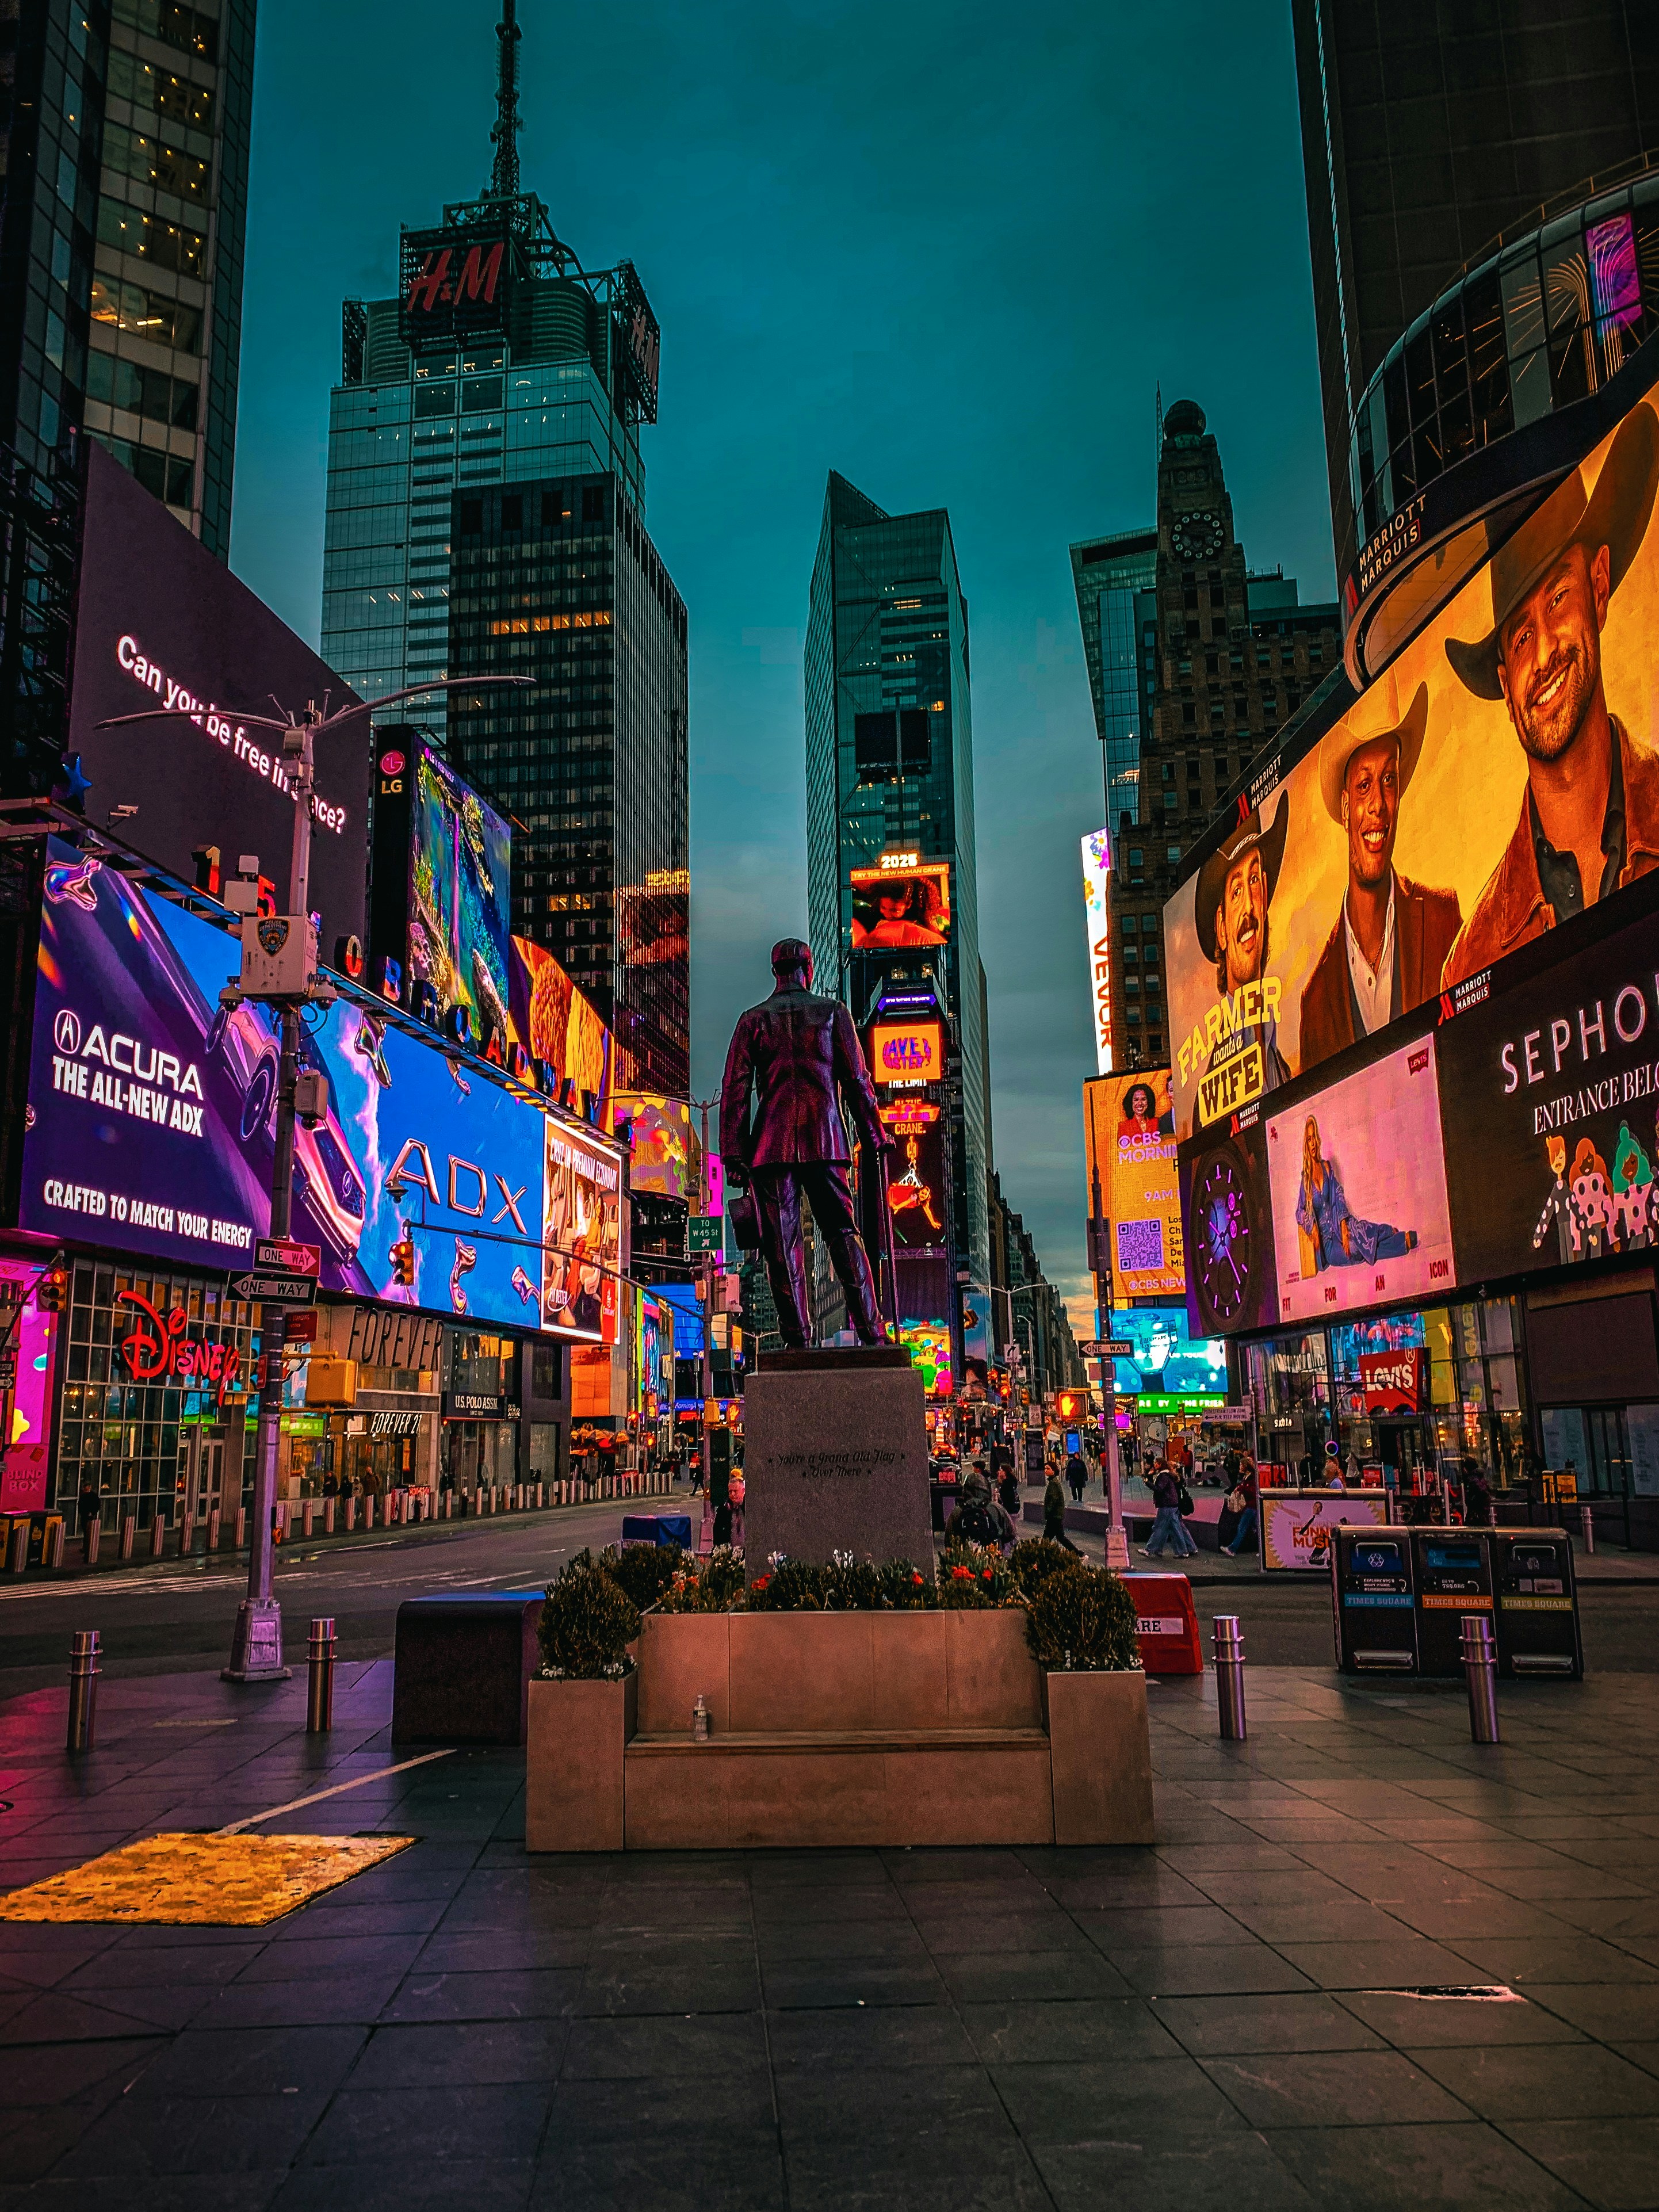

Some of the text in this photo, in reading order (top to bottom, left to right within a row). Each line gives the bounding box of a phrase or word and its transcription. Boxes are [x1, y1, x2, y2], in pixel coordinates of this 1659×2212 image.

[406, 242, 504, 312] H&M
[1360, 494, 1425, 572] MARRIOTT
[1362, 525, 1418, 593] MARQUIS
[117, 636, 162, 693] Can
[163, 677, 204, 725] you
[206, 704, 230, 746] be
[234, 727, 269, 777] free
[381, 780, 402, 794] LG
[1251, 754, 1281, 795] MARRIOTT
[1252, 774, 1279, 809] MARQUIS
[881, 853, 918, 869] 2025
[1456, 970, 1491, 999] MARRIOTT
[1457, 986, 1487, 1012] MARQUIS
[1177, 976, 1282, 1088] FARMER
[1502, 973, 1659, 1094] SEPHO
[81, 1025, 204, 1101] ACURA
[1213, 1034, 1243, 1067] wants a
[905, 1079, 927, 1087] LIMIT
[1201, 1050, 1260, 1118] WIFE
[52, 1056, 203, 1137] THE ALL-NEW ADX
[1534, 1076, 1619, 1134] ENTRANCE
[1240, 1102, 1260, 1119] MARRIOTT
[895, 1123, 926, 1135] CRANE.
[1132, 1131, 1161, 1147] CBS
[550, 1137, 617, 1192] CRUZ IN PREMIUM ECONOMY
[384, 1138, 527, 1235] ADX
[1144, 1189, 1172, 1202] 9AM
[44, 1179, 252, 1249] CRAFTED TO MATCH YOUR ENERGY
[264, 1249, 311, 1266] ONE WAY
[240, 1280, 305, 1296] ONE WAY
[1138, 1279, 1159, 1290] CBS
[1282, 1259, 1449, 1312] FIT FOR AN ICON
[347, 1305, 444, 1372] FOREVER
[1087, 1344, 1127, 1353] ONE WAY
[1365, 1365, 1413, 1391] LEVI'S
[455, 1396, 465, 1408] U.S.
[466, 1396, 482, 1408] POLO
[370, 1413, 422, 1437] FOREVER 21
[778, 1453, 805, 1466] You're
[808, 1455, 815, 1464] a
[853, 1450, 870, 1462] Old
[874, 1449, 895, 1464] Flag
[6, 1470, 44, 1480] BLIND
[9, 1481, 38, 1492] BOX
[1293, 1527, 1331, 1537] FUNN
[1424, 1598, 1453, 1606] TIMES
[1504, 1599, 1571, 1609] TIMES SQUARE
